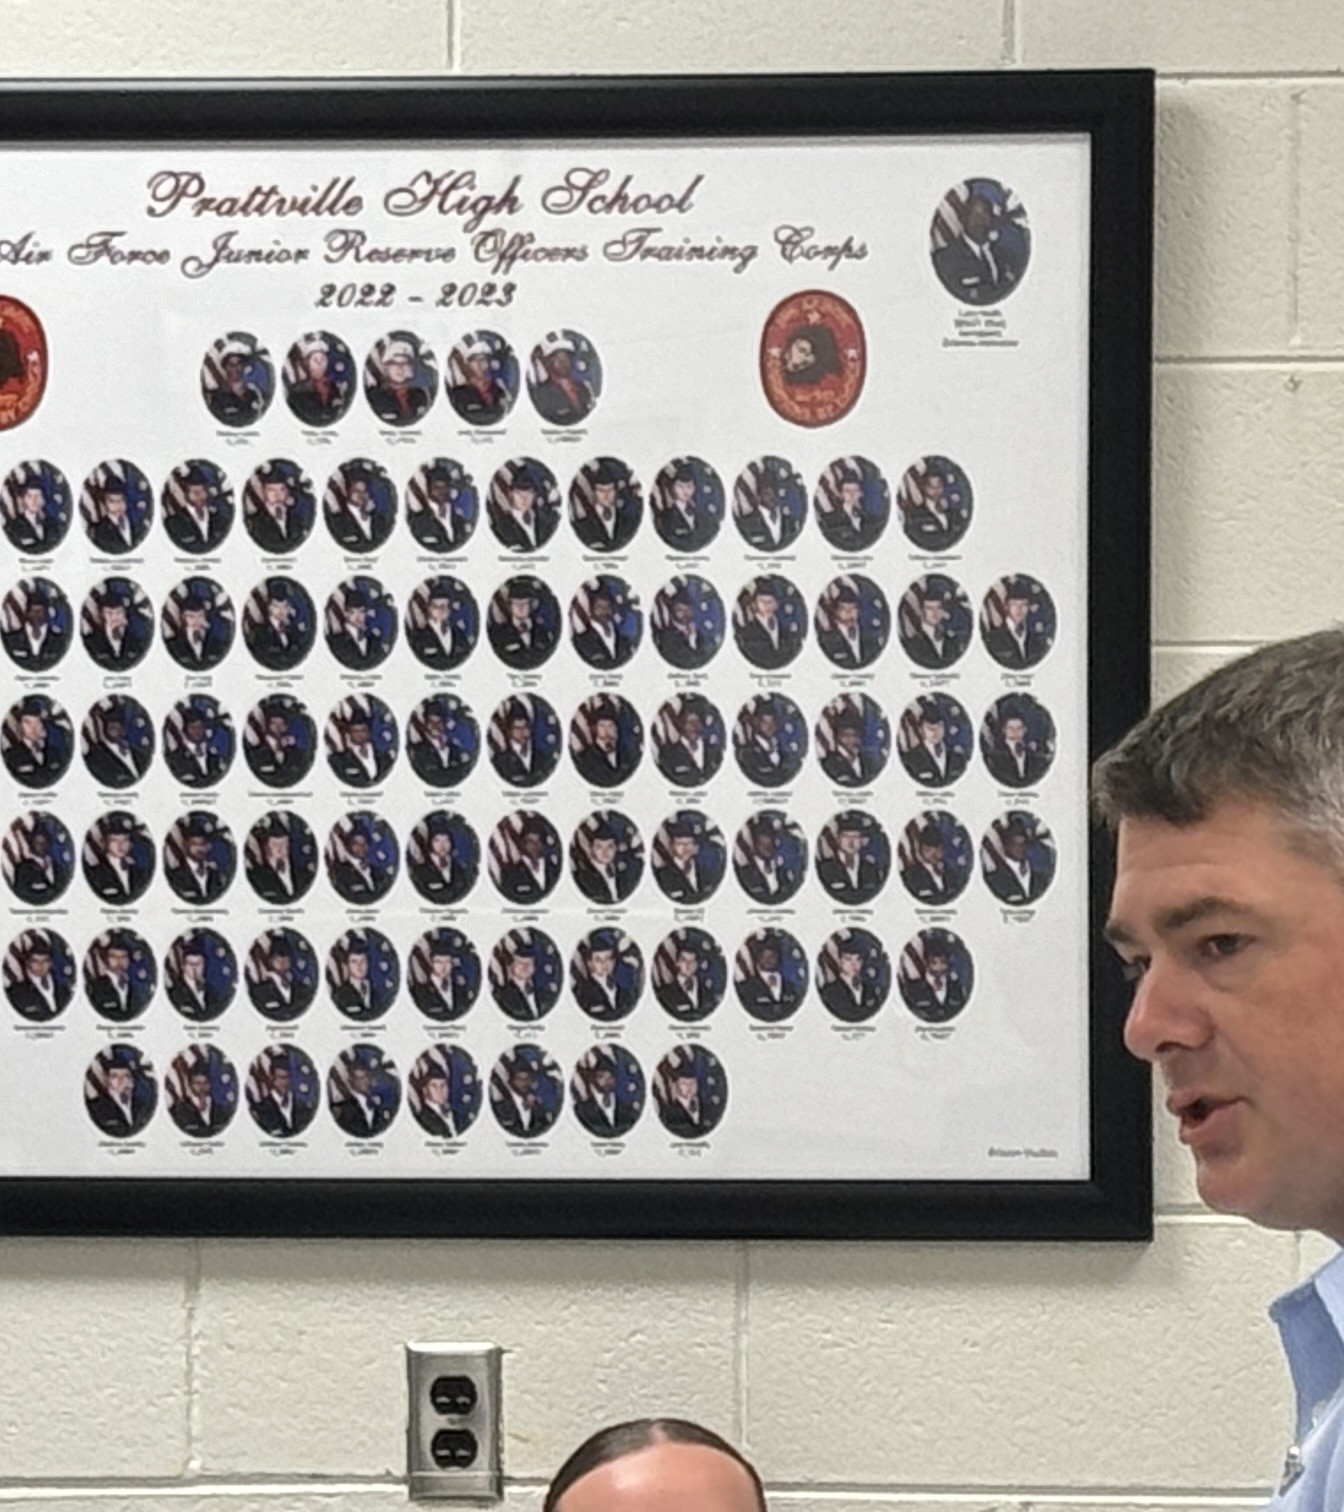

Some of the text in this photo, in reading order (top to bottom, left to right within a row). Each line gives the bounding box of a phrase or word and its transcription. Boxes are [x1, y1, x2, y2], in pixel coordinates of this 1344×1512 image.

[147, 168, 704, 232] Prattville High School
[68, 231, 171, 265] Force
[181, 231, 310, 279] Junior
[324, 229, 456, 263] Reserve
[470, 229, 589, 275] Officers
[603, 228, 758, 274] Training
[774, 225, 869, 271] Corps
[314, 282, 397, 308] 2022
[435, 282, 517, 308] 2023
